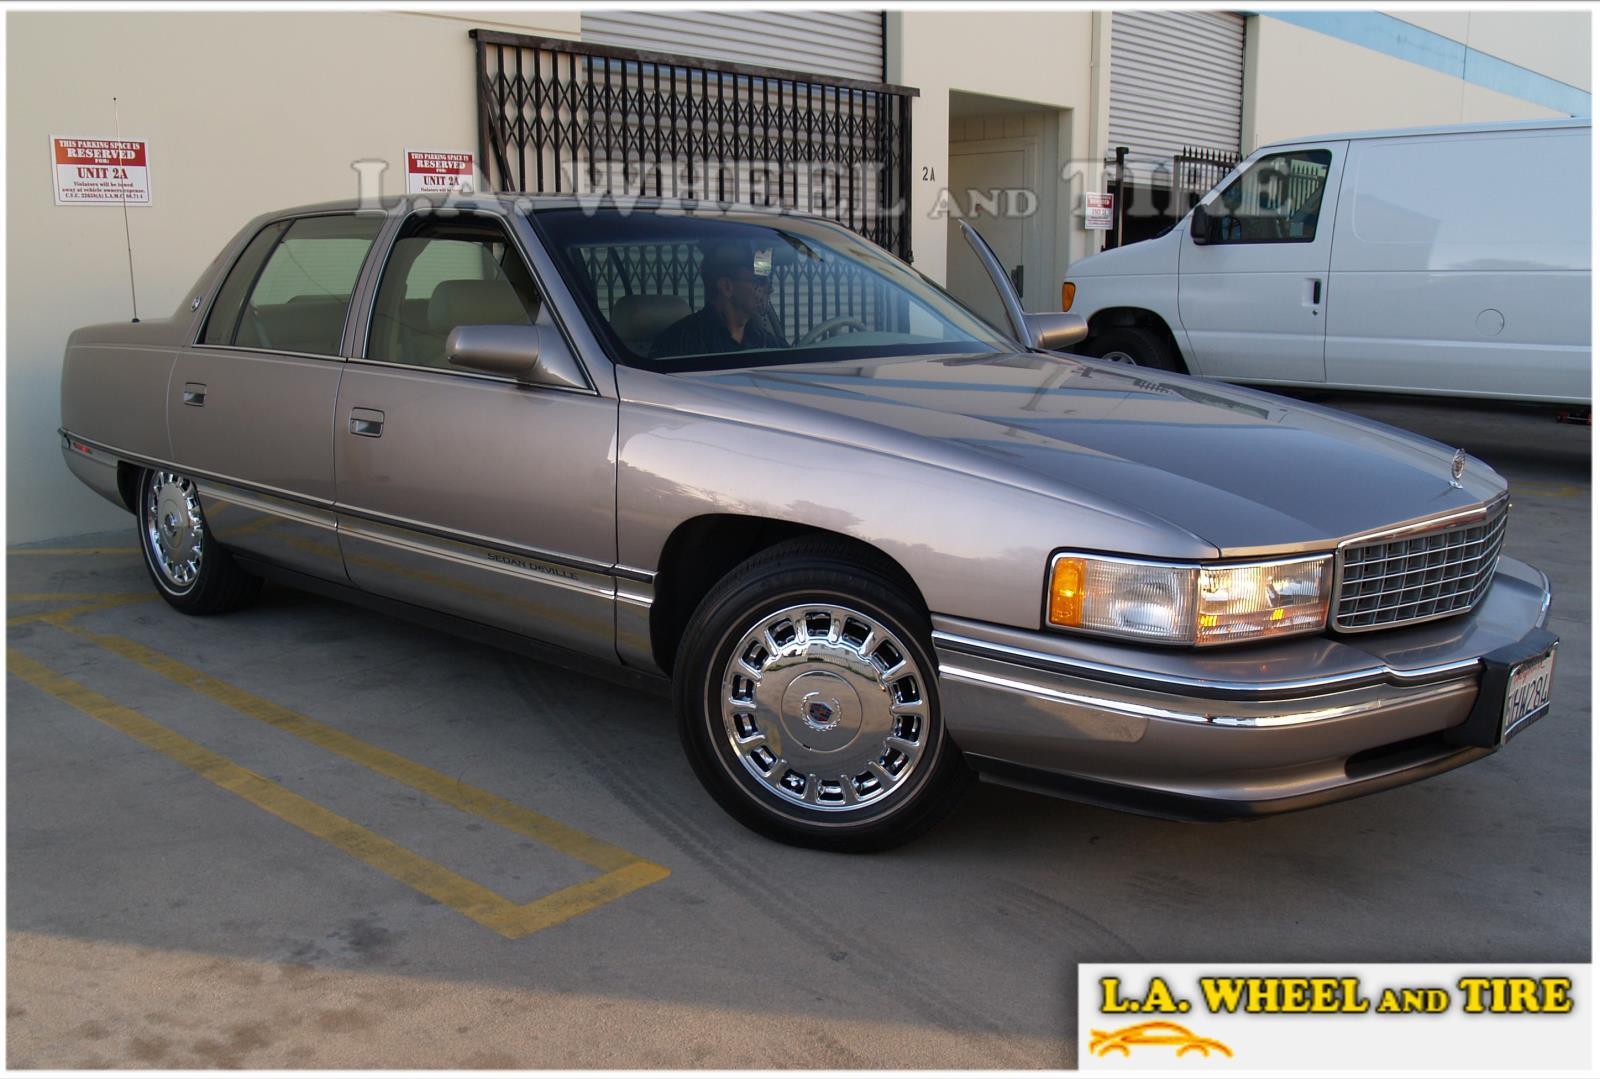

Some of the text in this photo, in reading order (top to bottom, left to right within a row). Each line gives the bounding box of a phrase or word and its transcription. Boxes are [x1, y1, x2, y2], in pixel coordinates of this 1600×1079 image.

[59, 140, 76, 148] THIS
[77, 141, 109, 149] PARKING
[110, 142, 132, 150] SPACE
[67, 148, 136, 159] RESERVED
[416, 159, 466, 170] RESERVED
[77, 167, 129, 180] UNIT 2A
[922, 166, 936, 182] 2A
[423, 175, 460, 186] UNIT 2A
[487, 552, 526, 568] SEDAN
